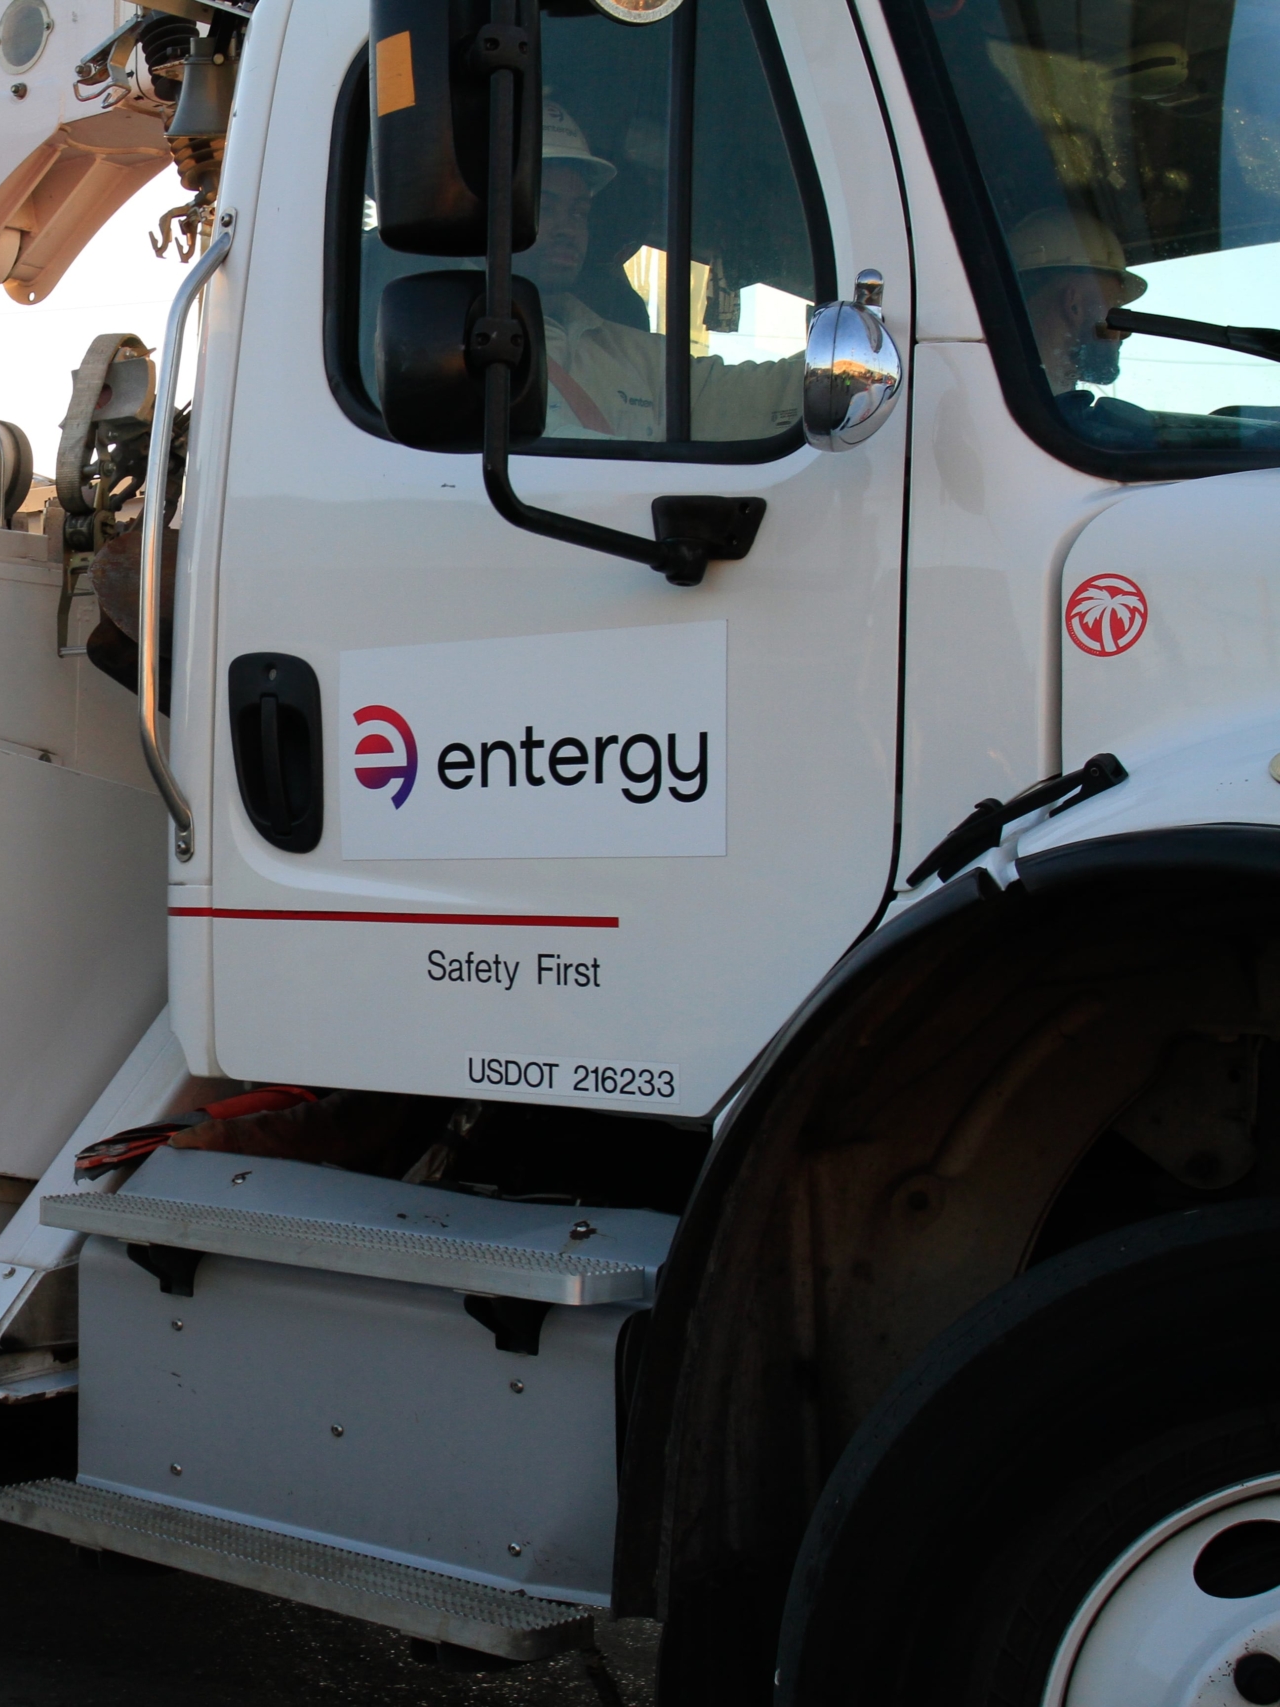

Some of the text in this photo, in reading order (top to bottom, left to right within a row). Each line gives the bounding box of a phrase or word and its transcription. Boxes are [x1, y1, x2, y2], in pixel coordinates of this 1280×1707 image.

[437, 725, 708, 804] entergy
[427, 949, 601, 991] Safety First
[468, 1056, 676, 1099] USDOT 216233
